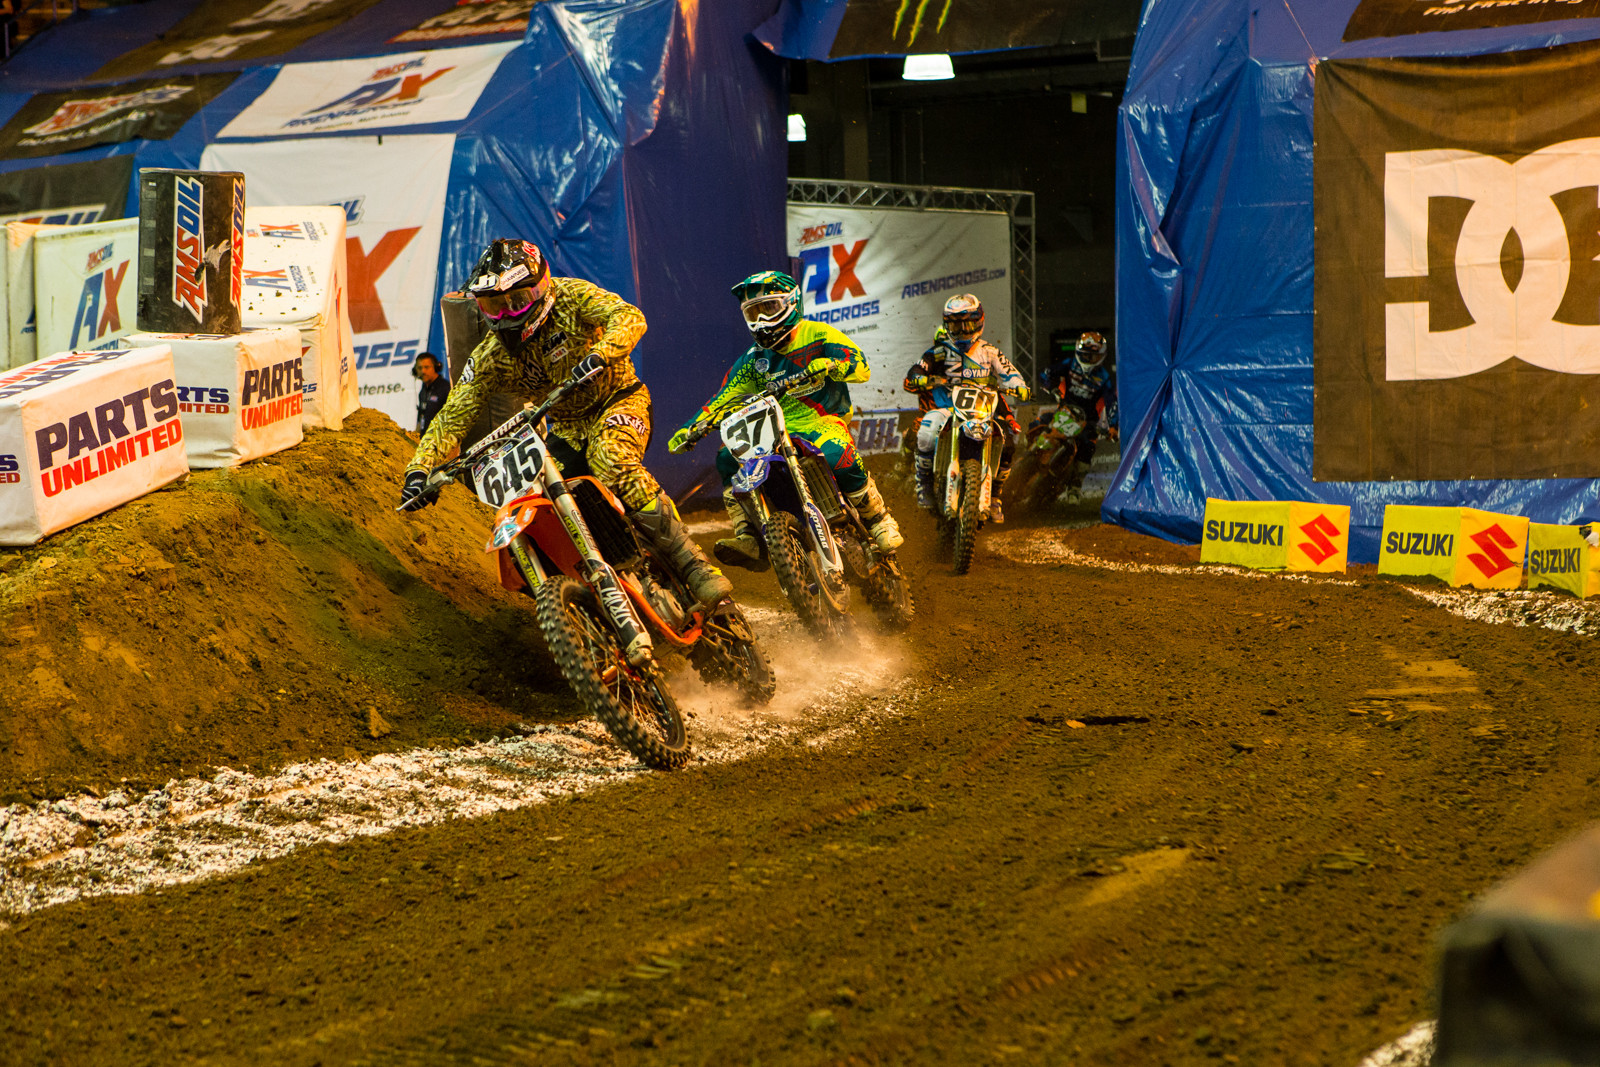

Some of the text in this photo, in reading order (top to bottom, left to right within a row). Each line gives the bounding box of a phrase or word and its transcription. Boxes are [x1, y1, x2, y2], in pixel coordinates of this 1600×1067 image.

[174, 177, 206, 320] AMSOIL
[801, 222, 843, 245] AMSOIL
[801, 239, 869, 305] AX
[69, 259, 130, 351] AX
[242, 357, 302, 406] PARTS
[35, 379, 178, 470] PARTS
[242, 393, 302, 431] UNLIMITED
[41, 419, 182, 498] UNLIMITED
[483, 437, 543, 507] 645
[1206, 519, 1283, 546] SUZUKI
[1386, 531, 1454, 557] SUZUKI
[1530, 548, 1581, 574] SUZUKI
